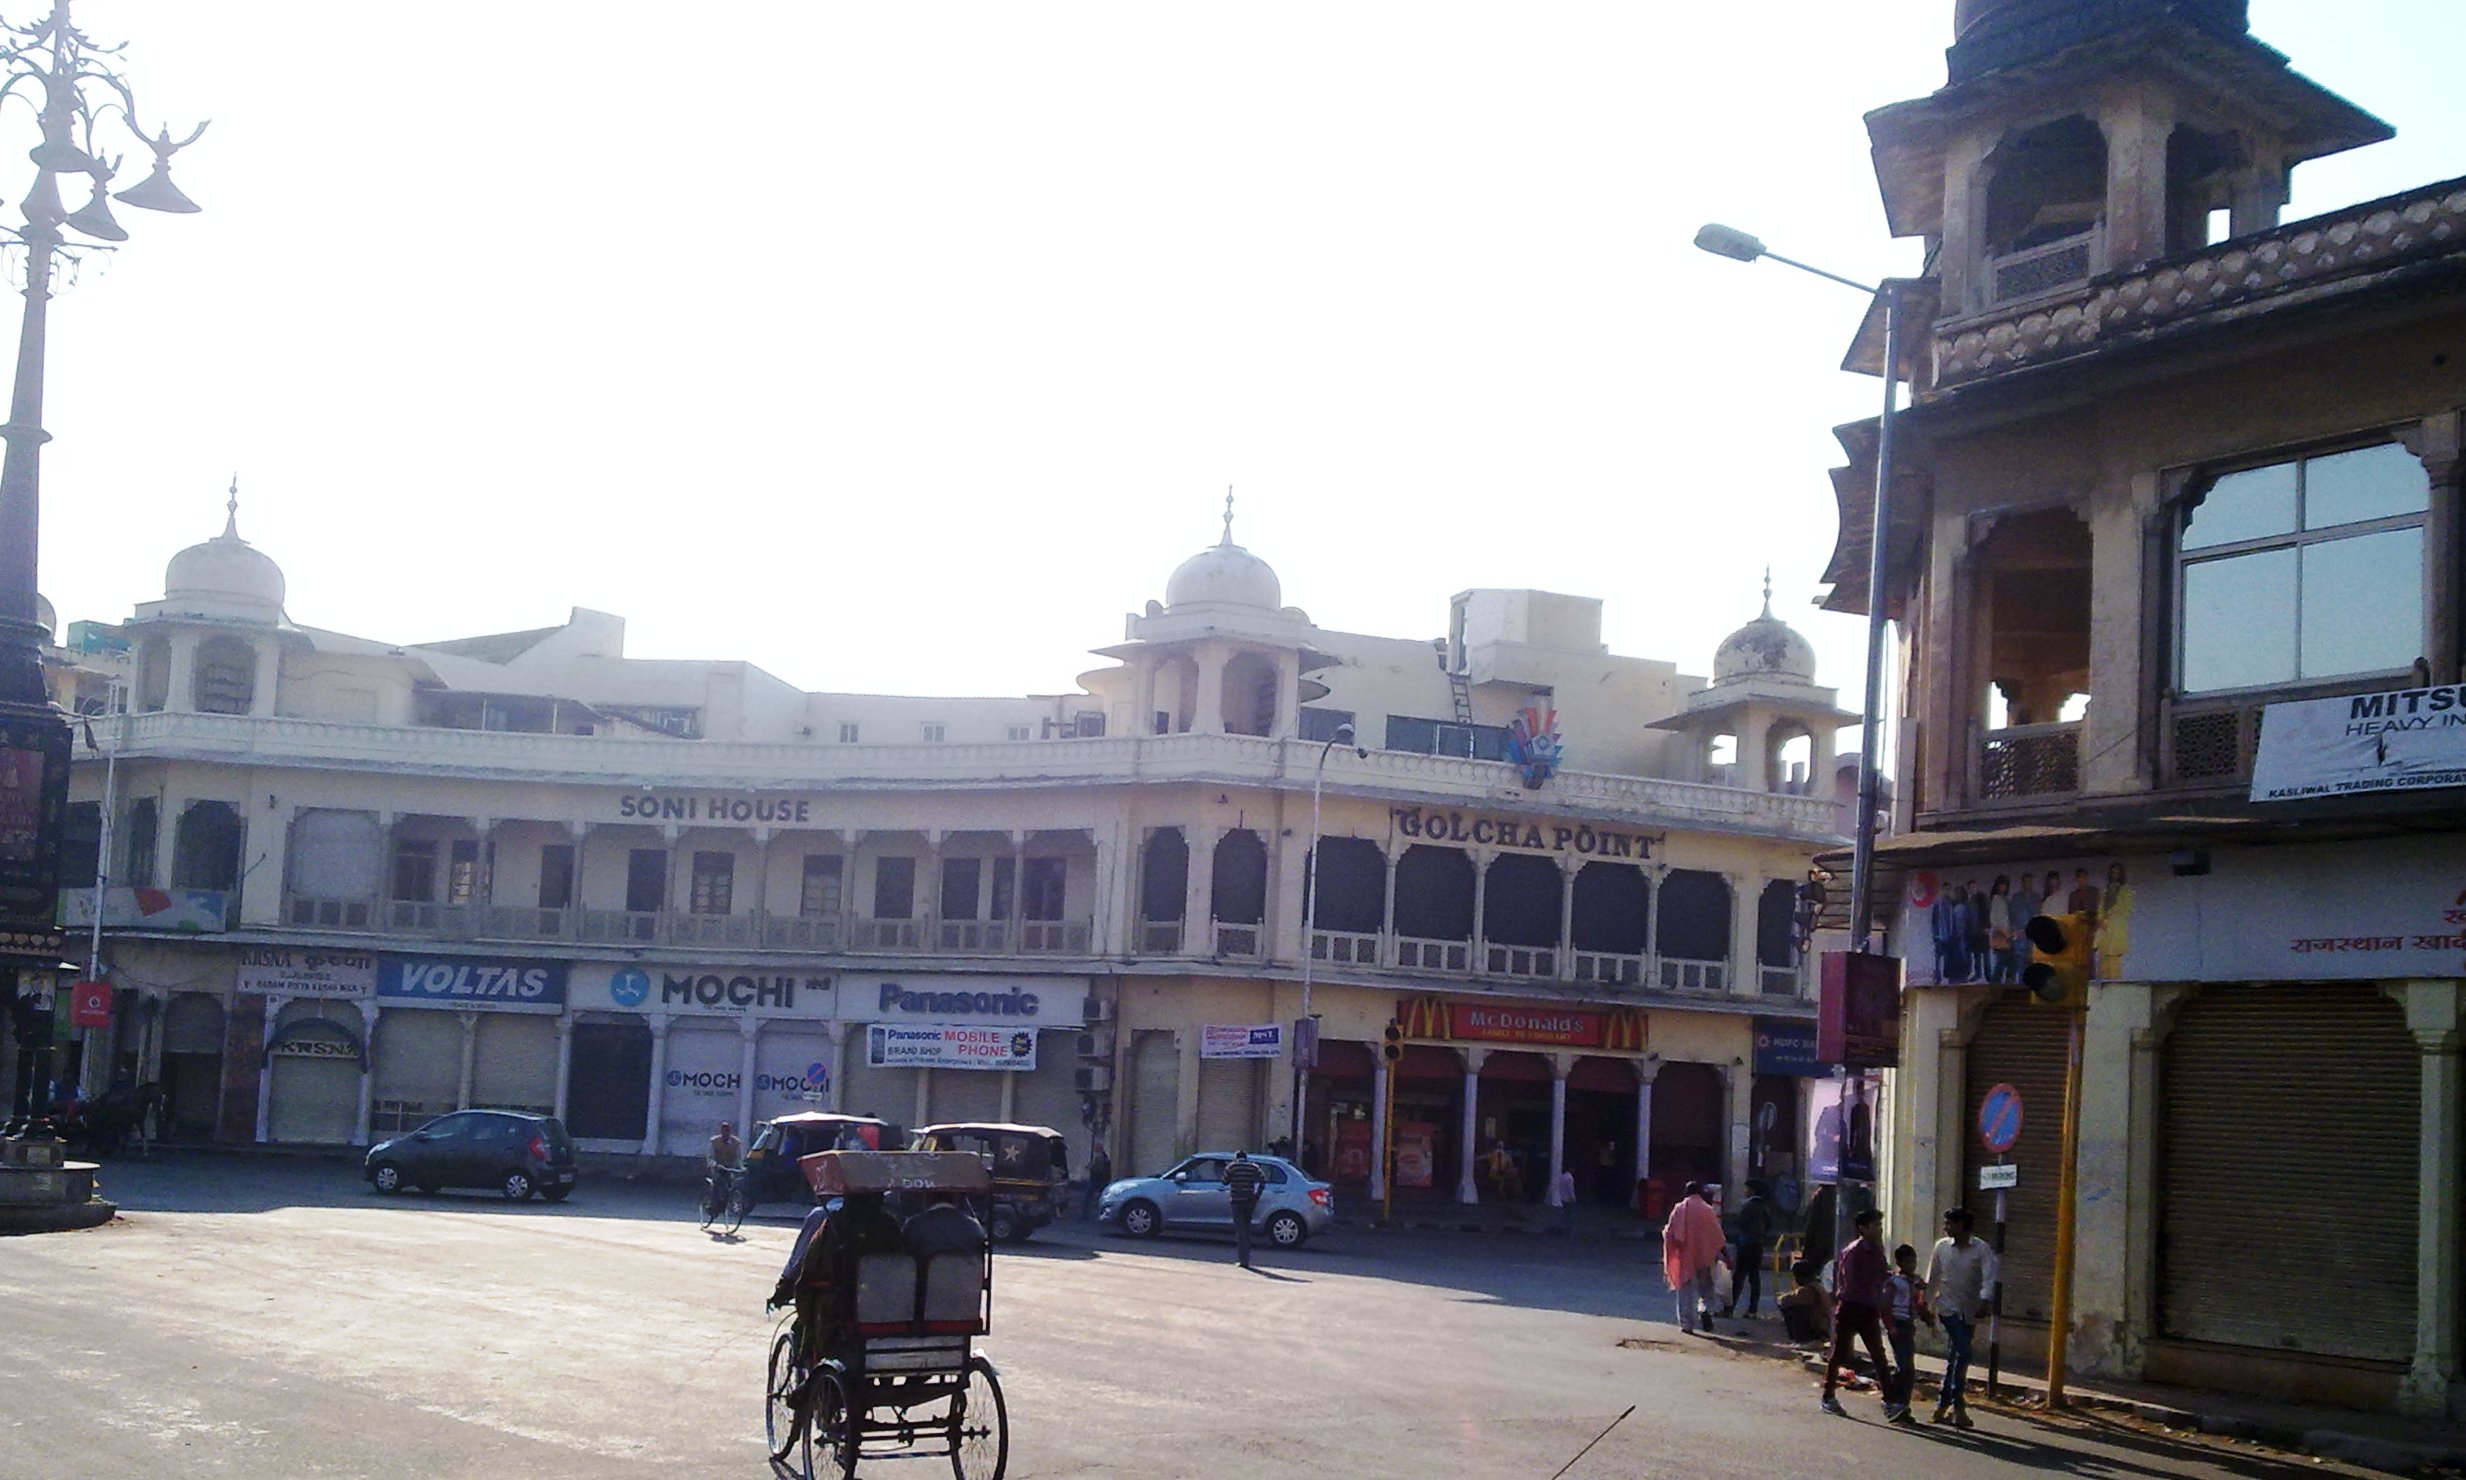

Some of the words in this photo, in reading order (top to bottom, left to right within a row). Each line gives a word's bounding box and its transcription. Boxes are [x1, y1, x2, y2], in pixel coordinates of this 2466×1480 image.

[2351, 685, 2466, 719] MITS
[2346, 715, 2434, 736] HEAVY
[2269, 785, 2330, 798] KASLIWAL
[2336, 777, 2394, 791] TRADING
[620, 794, 697, 819] SONI
[708, 797, 810, 822] HOUSE
[1399, 807, 1545, 849] GOLCHA
[1552, 824, 1655, 859] POINT
[401, 962, 549, 998] VOLTAS
[661, 973, 795, 1008] MOCHI
[879, 983, 1040, 1016] Panasonic
[1470, 1011, 1585, 1033] McDonald's
[888, 1029, 941, 1041] Panasonic
[944, 1030, 1000, 1044] MOBILE
[958, 1044, 1008, 1057] PHONE
